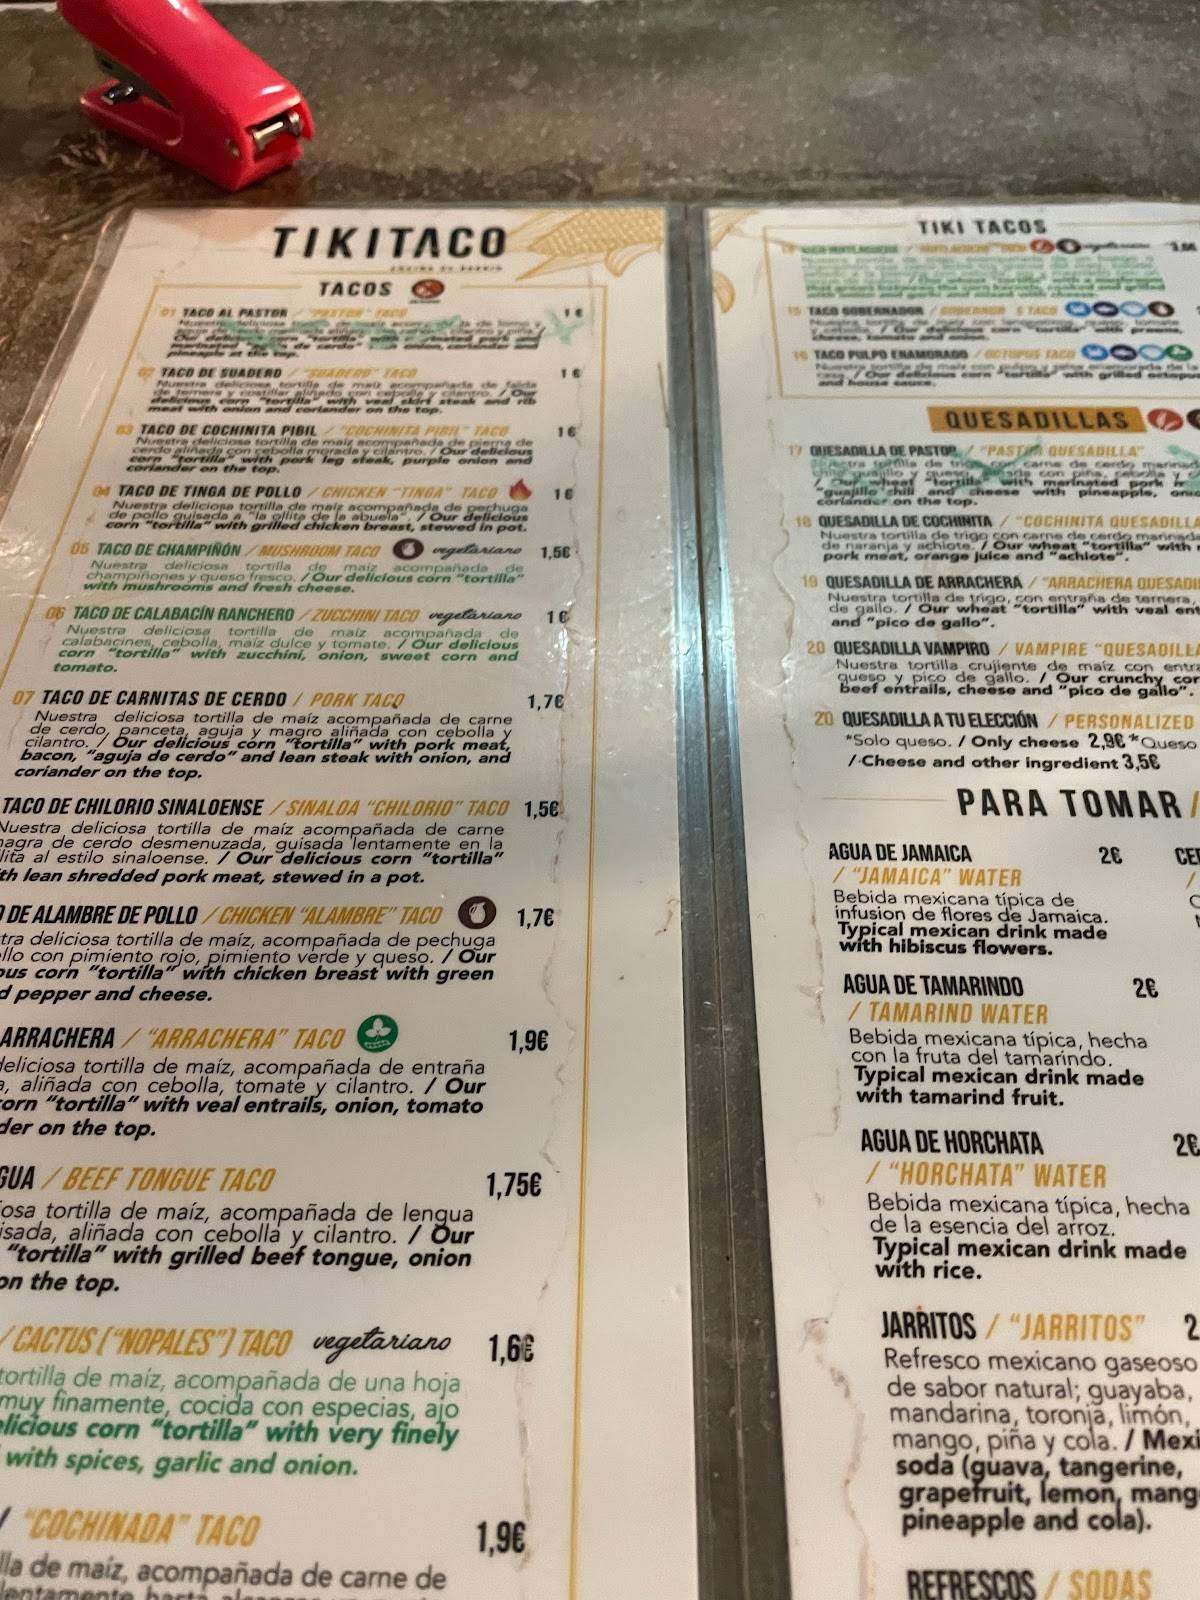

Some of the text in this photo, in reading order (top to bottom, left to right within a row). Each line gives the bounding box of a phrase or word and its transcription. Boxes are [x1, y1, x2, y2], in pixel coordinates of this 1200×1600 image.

[918, 219, 1046, 234] TIKI TACOS
[275, 227, 505, 258] TIKITACO
[320, 281, 391, 296] TACOS
[183, 307, 214, 317] TACO
[218, 308, 232, 318] AL
[238, 308, 287, 317] PASTOR
[808, 306, 838, 316] TACO
[842, 306, 923, 316] GOBERNADOR
[814, 349, 844, 359] TACO
[848, 349, 887, 359] PULPO
[891, 349, 968, 359] ENAMORADO
[161, 367, 281, 378] TACO DE SUADERO
[943, 409, 1131, 430] QUESADILLAS
[139, 424, 315, 438] TACO DE COCHINITA PIBIL
[119, 484, 301, 498] TACO DE TINGA DE POLLO
[818, 514, 992, 527] QUESADILLA DE COCHINITA
[97, 542, 240, 556] TACO DE CHAMPIÑÓN
[257, 544, 381, 557] MUSHROOM TACO
[432, 543, 521, 559] vegetariano
[826, 575, 1022, 589] QUESADILLA DE ARRACHERA
[73, 605, 294, 621] TACO DE CALABACÍN RANCHERO
[310, 608, 420, 622] ZUCCHINI TACO
[429, 608, 521, 626] vegetariano
[831, 615, 994, 630] and "pico de gallo".
[834, 641, 989, 655] QUESADILLA VAMPIRO
[42, 690, 286, 706] TACO DE CARNITAS DE CERDO
[528, 694, 564, 710] 1,7€
[843, 710, 1037, 728] QUESADILLA A TU ELECCIÓN
[971, 732, 1125, 750] Only cheese 2,9€
[859, 753, 1160, 771] Cheese and other ingredient 3,5€
[15, 765, 201, 781] coriander on the top.
[2, 797, 263, 815] TACO DE CHILORIO SINALOENSE
[286, 799, 510, 816] SINALOA "CHILORIO" TACO
[525, 800, 563, 819] 1,5€
[957, 788, 1180, 817] PARA TOMAR
[829, 843, 971, 862] AGUA DE JAMAICA
[1099, 846, 1122, 864] 2€
[853, 866, 1021, 886] "JAMAICA" WATER
[219, 906, 443, 924] CHICKEN "ALAMBRE" TACO
[518, 908, 554, 928] 1,7€
[844, 973, 1023, 996] AGUA DE TAMARINDO
[1133, 978, 1158, 998] 2€
[14, 986, 211, 1004] pepper and cheese.
[870, 1001, 1047, 1024] TAMARIND WATER
[0, 1027, 114, 1048] ARRACHERA
[150, 1028, 345, 1049] "ARRACHERA" TACO
[510, 1030, 548, 1053] 1,9€
[857, 1086, 1063, 1106] with tamarind fruit.
[861, 1128, 1043, 1154] AGUA DE HORCHATA
[62, 1167, 275, 1192] BEEF TONGUE TACO
[891, 1161, 1106, 1187] "HORCHATA" WATER
[487, 1172, 541, 1199] 1,75€
[875, 1258, 981, 1279] with rice.
[882, 1311, 975, 1339] JARRITOS
[1011, 1313, 1143, 1341] "JARRITOS"
[13, 1325, 293, 1357] CACTUS ("NOPALES") TACO
[313, 1327, 450, 1363] vegetariano
[490, 1334, 534, 1365] 1,6€
[5, 1447, 357, 1478] with spices, garlic and onion.
[902, 1507, 1150, 1536] pineapple and cola).
[478, 1521, 525, 1556] 1,9€
